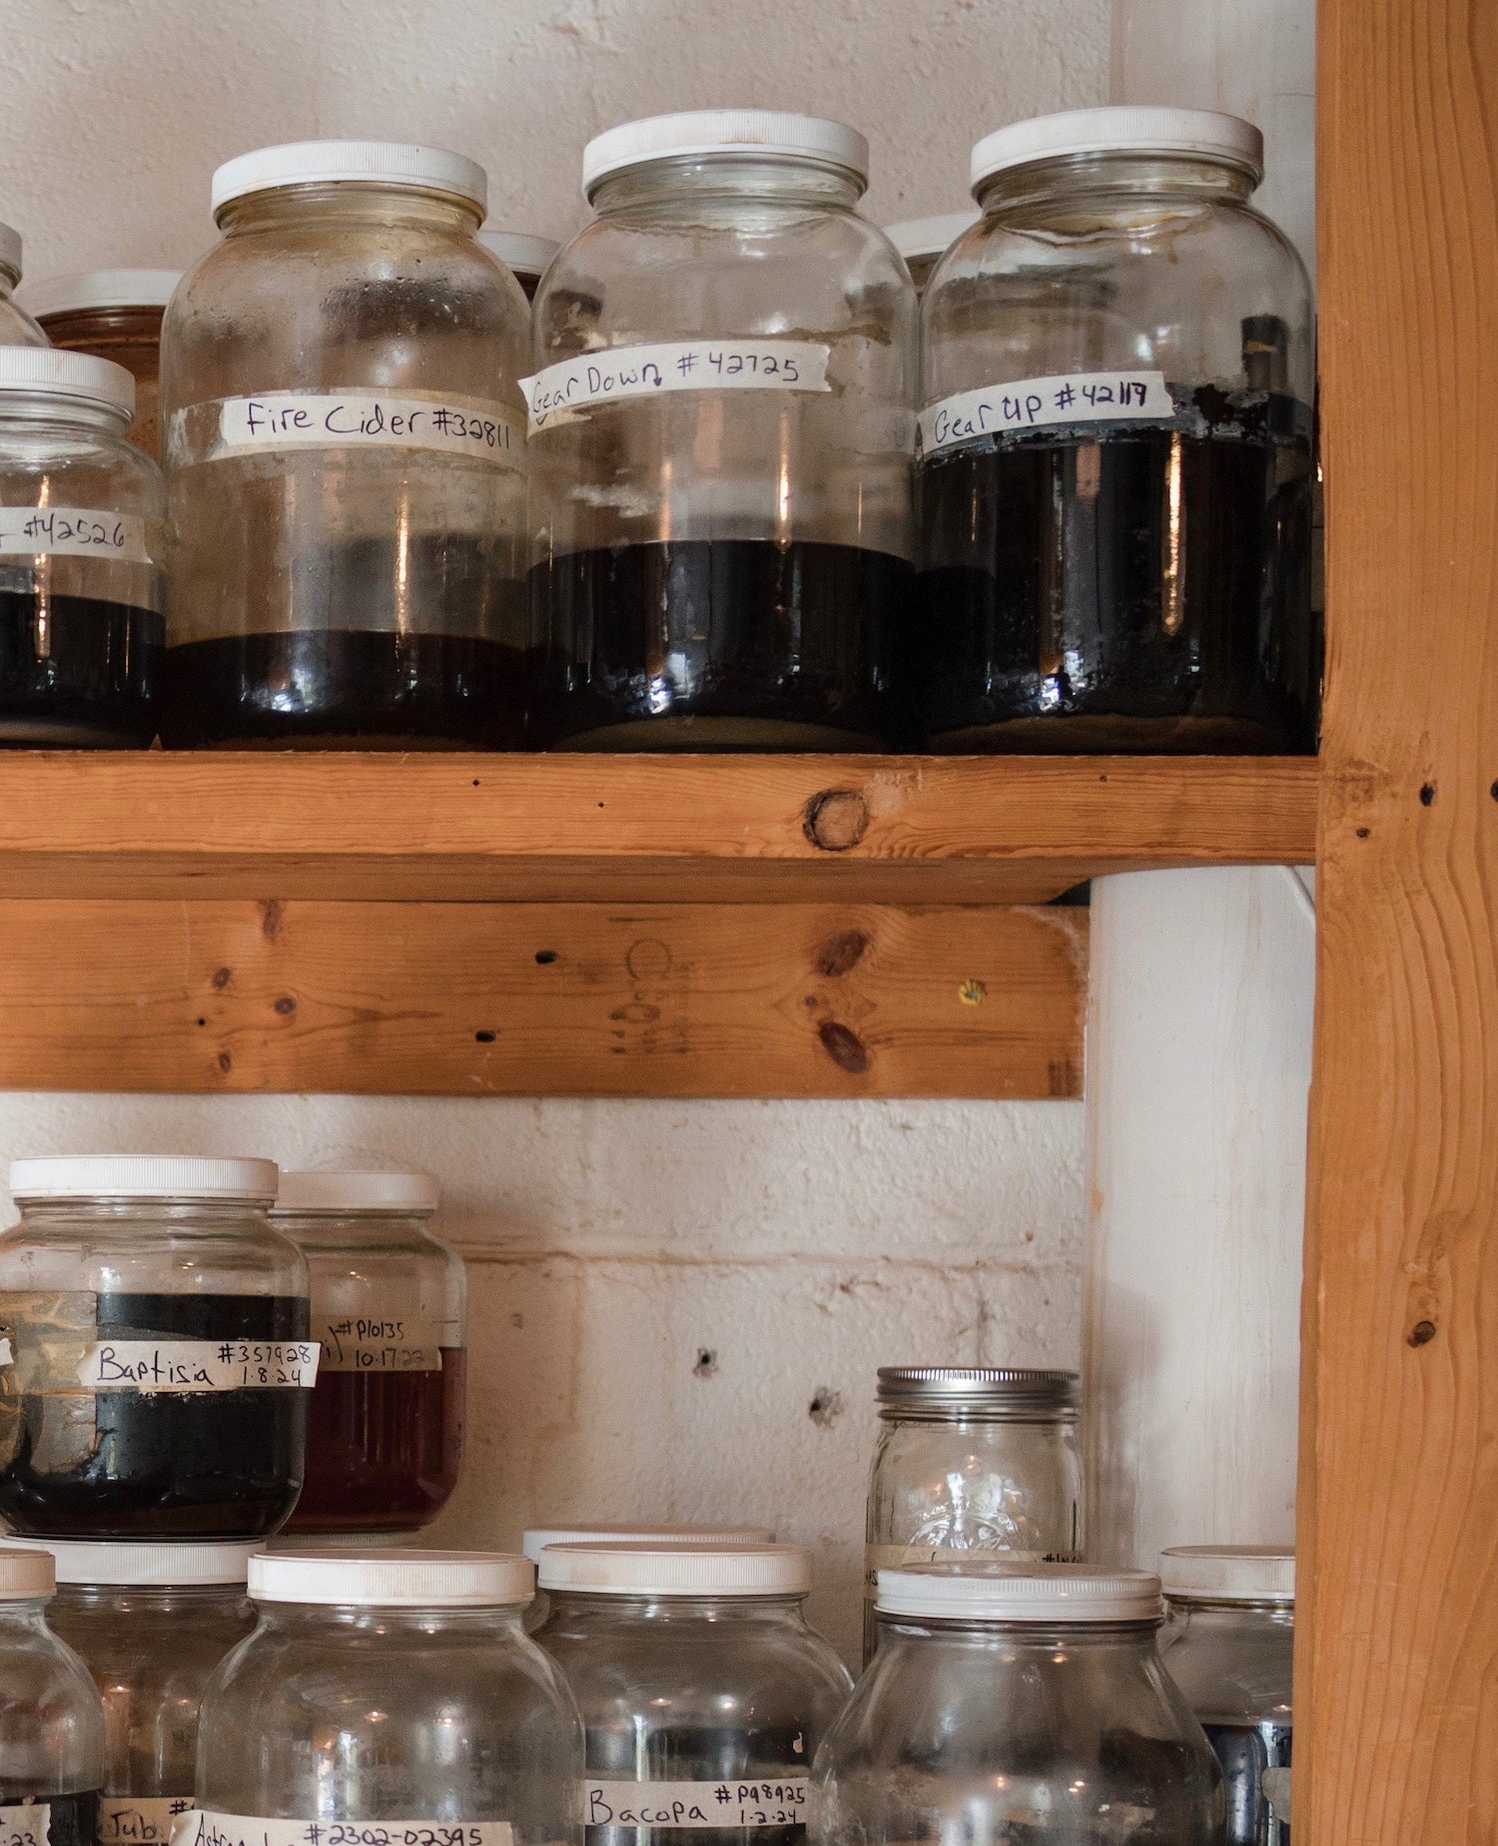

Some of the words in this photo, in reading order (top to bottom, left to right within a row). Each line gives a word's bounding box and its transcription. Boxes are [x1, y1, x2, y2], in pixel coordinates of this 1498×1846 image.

[532, 377, 579, 413] Gear
[588, 363, 663, 394] Down
[246, 403, 312, 434] Fire
[326, 405, 424, 437] Cider
[432, 408, 510, 449] #32811
[934, 404, 993, 444] Gear
[23, 514, 126, 551] #42526
[96, 1346, 215, 1386] Baptisia
[589, 1788, 708, 1826] Bacopa
